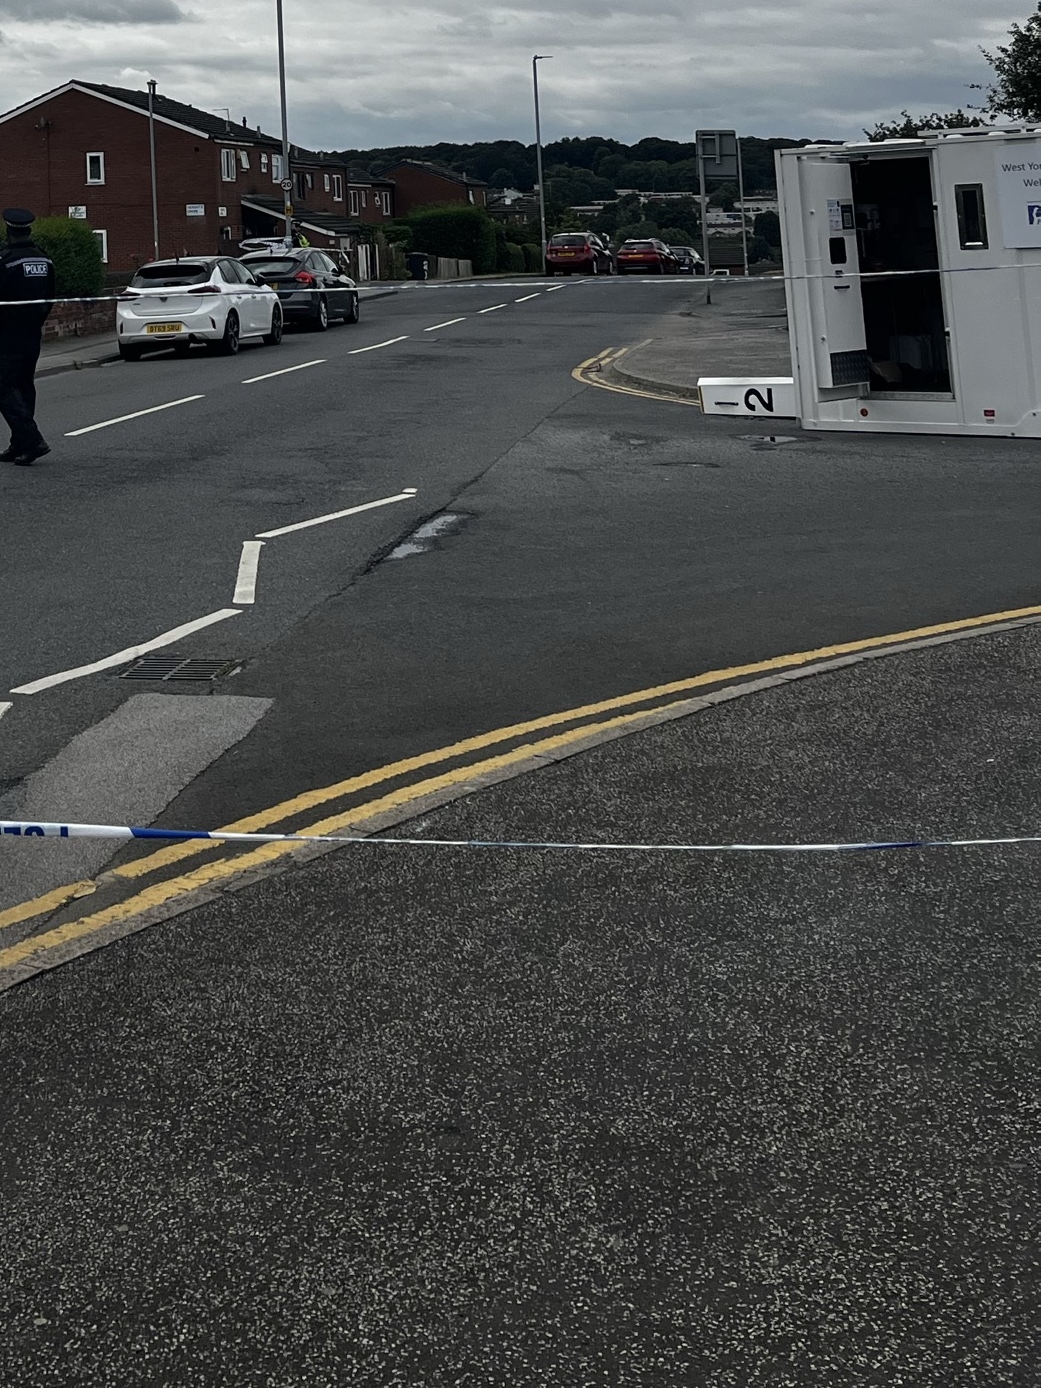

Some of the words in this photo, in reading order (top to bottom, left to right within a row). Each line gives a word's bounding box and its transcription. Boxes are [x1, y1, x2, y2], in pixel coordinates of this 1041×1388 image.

[1001, 163, 1026, 172] West
[25, 264, 48, 275] POLICE
[744, 388, 774, 412] 2
